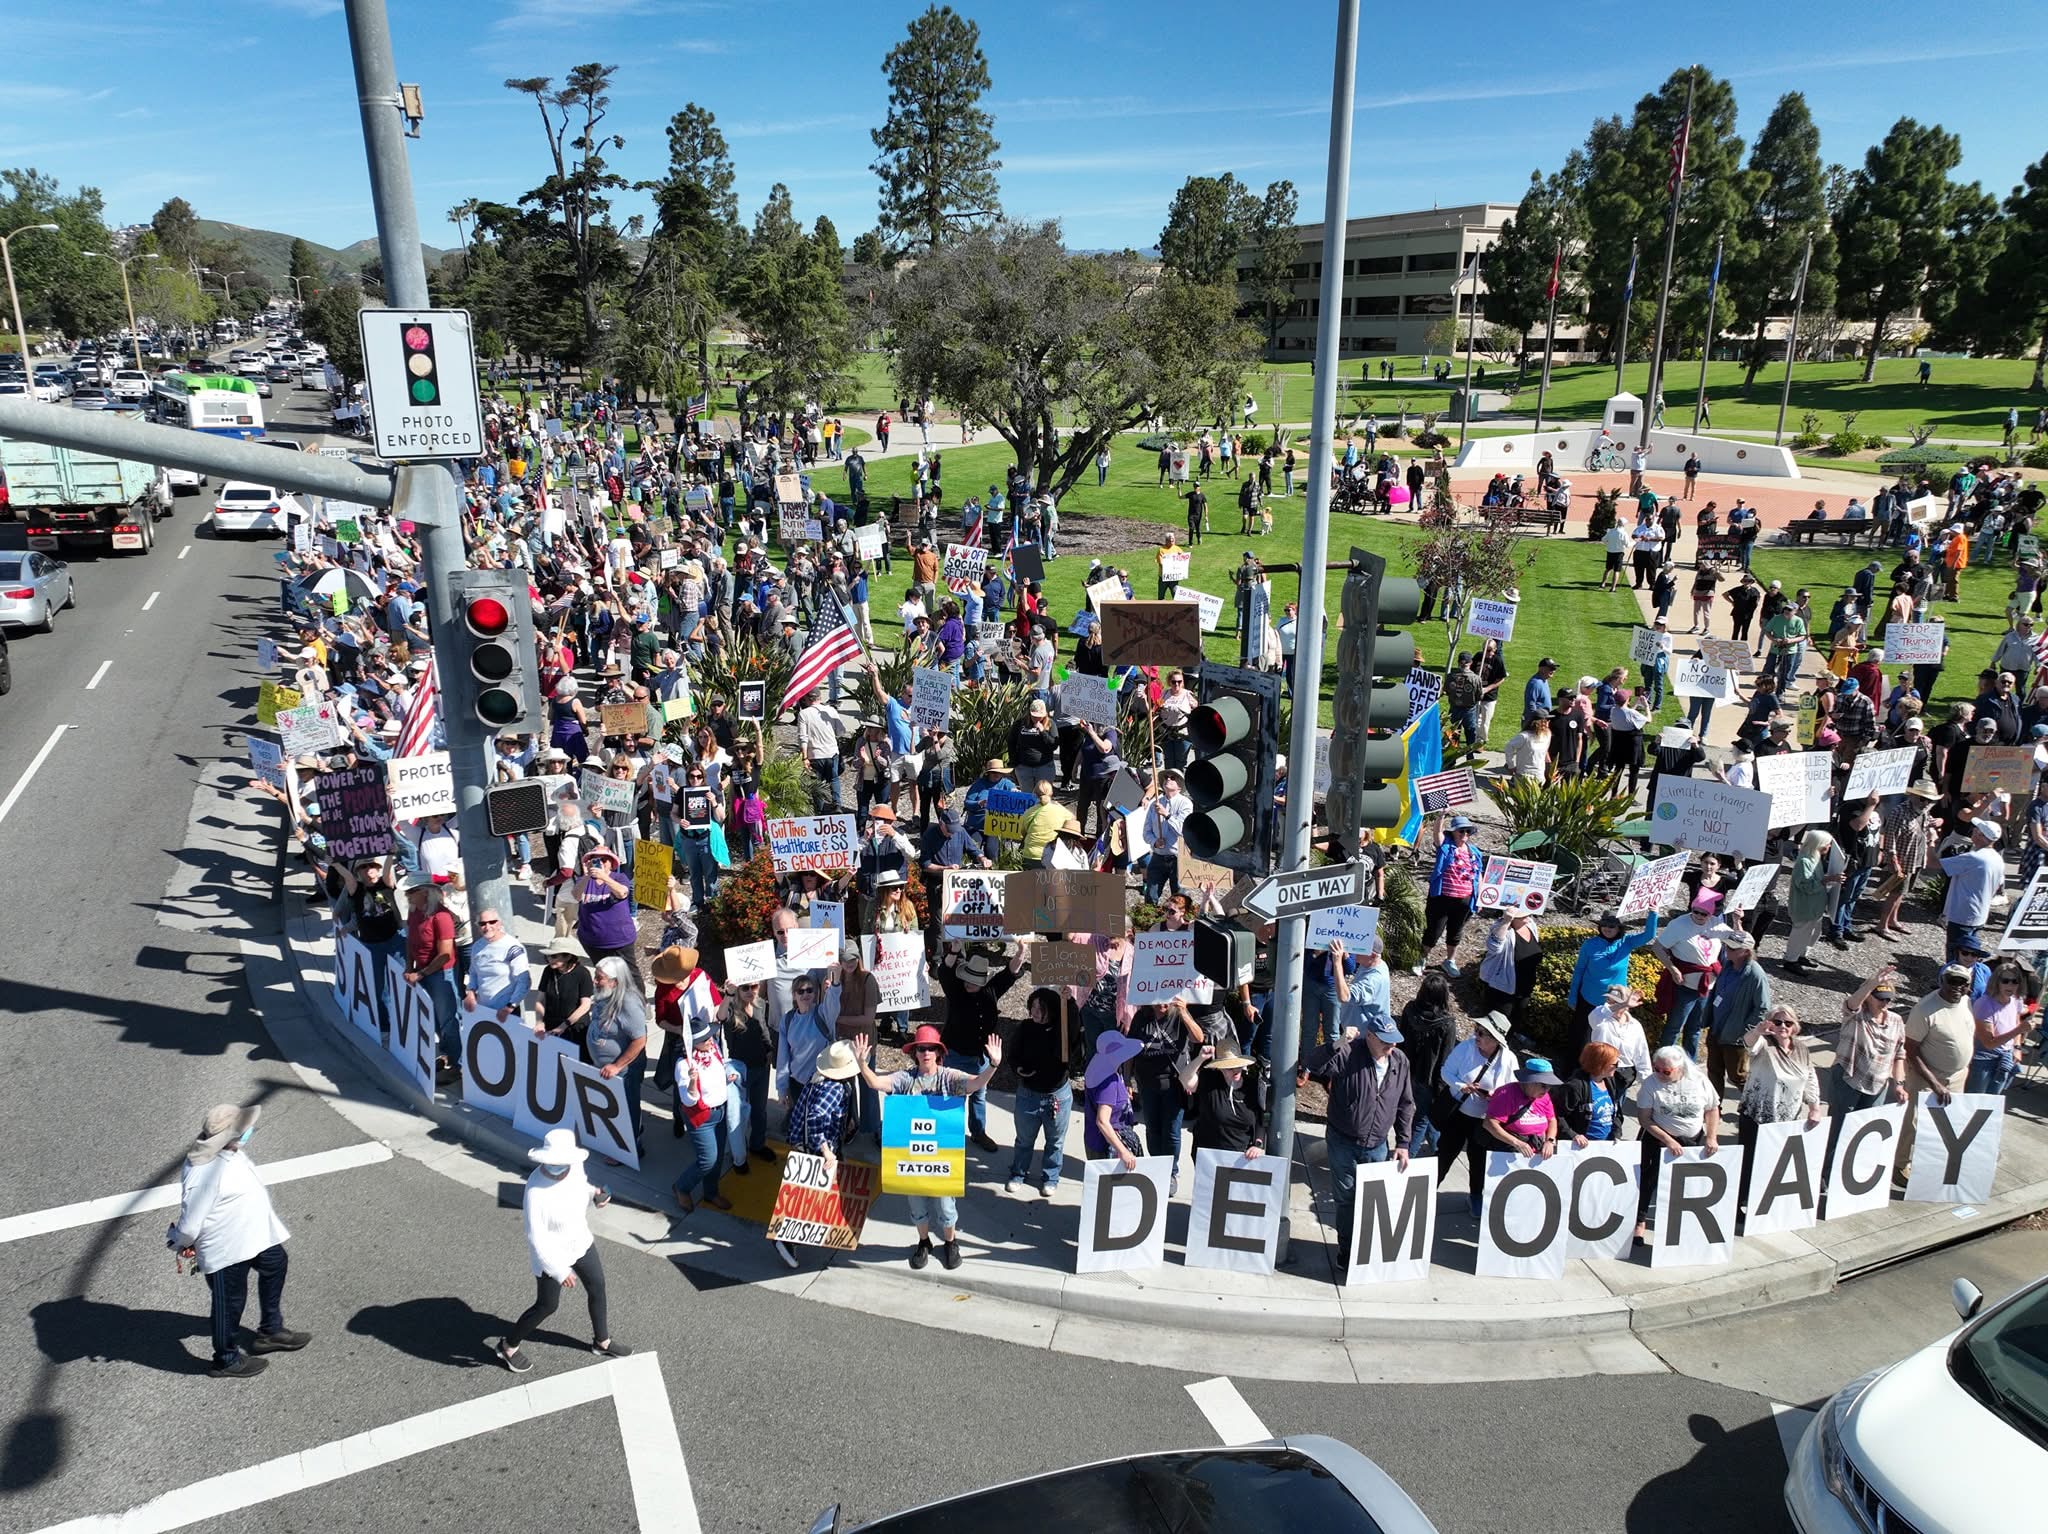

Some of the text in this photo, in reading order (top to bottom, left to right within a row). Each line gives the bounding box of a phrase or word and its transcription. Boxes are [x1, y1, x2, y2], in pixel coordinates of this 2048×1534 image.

[402, 415, 454, 429] PHOTO
[387, 432, 472, 447] ENFORCED
[320, 449, 346, 457] SPEED
[779, 501, 807, 511] TRUMP
[783, 511, 806, 520] MUSK
[783, 520, 805, 529] PUTIN
[970, 550, 988, 561] OFF
[946, 557, 984, 571] SOCIAL
[944, 566, 984, 582] SECURITY
[1179, 589, 1187, 597] So
[1204, 596, 1219, 605] even
[1474, 601, 1514, 615] VETERANS
[1476, 614, 1505, 625] AGAINST
[1470, 625, 1505, 639] FASCISM
[1638, 630, 1656, 643] SAVE
[1902, 625, 1930, 634] STOP
[1635, 650, 1656, 664] RIGHTS
[1895, 652, 1939, 660] DESTRUCTION
[1690, 662, 1710, 674] NO
[1407, 670, 1441, 691] HANDS
[1680, 672, 1726, 685] DICTATORS
[743, 694, 761, 702] OFF!
[916, 692, 945, 704] CHILDREN
[933, 689, 943, 697] MY
[914, 705, 945, 718] NOT STAY
[917, 714, 943, 728] SILENT
[315, 768, 375, 790] POWER TO
[1805, 769, 1830, 781] PUBLIC
[320, 784, 385, 812] THE PEOPLE
[393, 789, 450, 810] DEMOCR
[687, 801, 707, 809] OFF!
[994, 794, 1035, 811] TRUMP
[1714, 791, 1754, 814] change
[1688, 806, 1724, 821] denial
[350, 811, 389, 833] STRONGER
[813, 818, 847, 835] Jobs
[991, 819, 1020, 833] PUTI
[1683, 818, 1731, 836] is NOT
[327, 834, 391, 858] TOGETHER
[831, 834, 849, 850] SS
[1680, 832, 1729, 848] a policy
[637, 840, 664, 857] STOP
[791, 850, 858, 871] GENOCIDE!
[951, 876, 1005, 889] Keep You
[1631, 868, 1683, 891] SOCIAL SECURITY
[1064, 884, 1100, 896] US OUT
[1278, 877, 1351, 904] ONE WAY
[1633, 883, 1669, 899] MEDICARE
[816, 903, 837, 911] WHAT
[1623, 893, 1661, 914] MEDICAID
[1327, 905, 1360, 919] HONK
[1337, 919, 1344, 928] 4
[1139, 939, 1195, 950] DEMOCRA
[880, 950, 908, 960] MAKE
[1154, 954, 1188, 965] NOT
[872, 960, 918, 971] AMERICA
[1137, 978, 1207, 993] OLIGARCHY
[467, 1020, 631, 1153] OUR
[914, 1122, 933, 1131] NO
[912, 1143, 934, 1152] DIC
[784, 1155, 829, 1188] SUCKS
[898, 1163, 950, 1174] TATORS
[1092, 1108, 1992, 1265] DEMOCRACY
[773, 1186, 866, 1229] HANDMAIDS
[769, 1218, 856, 1249] THIS EPISODE OF
